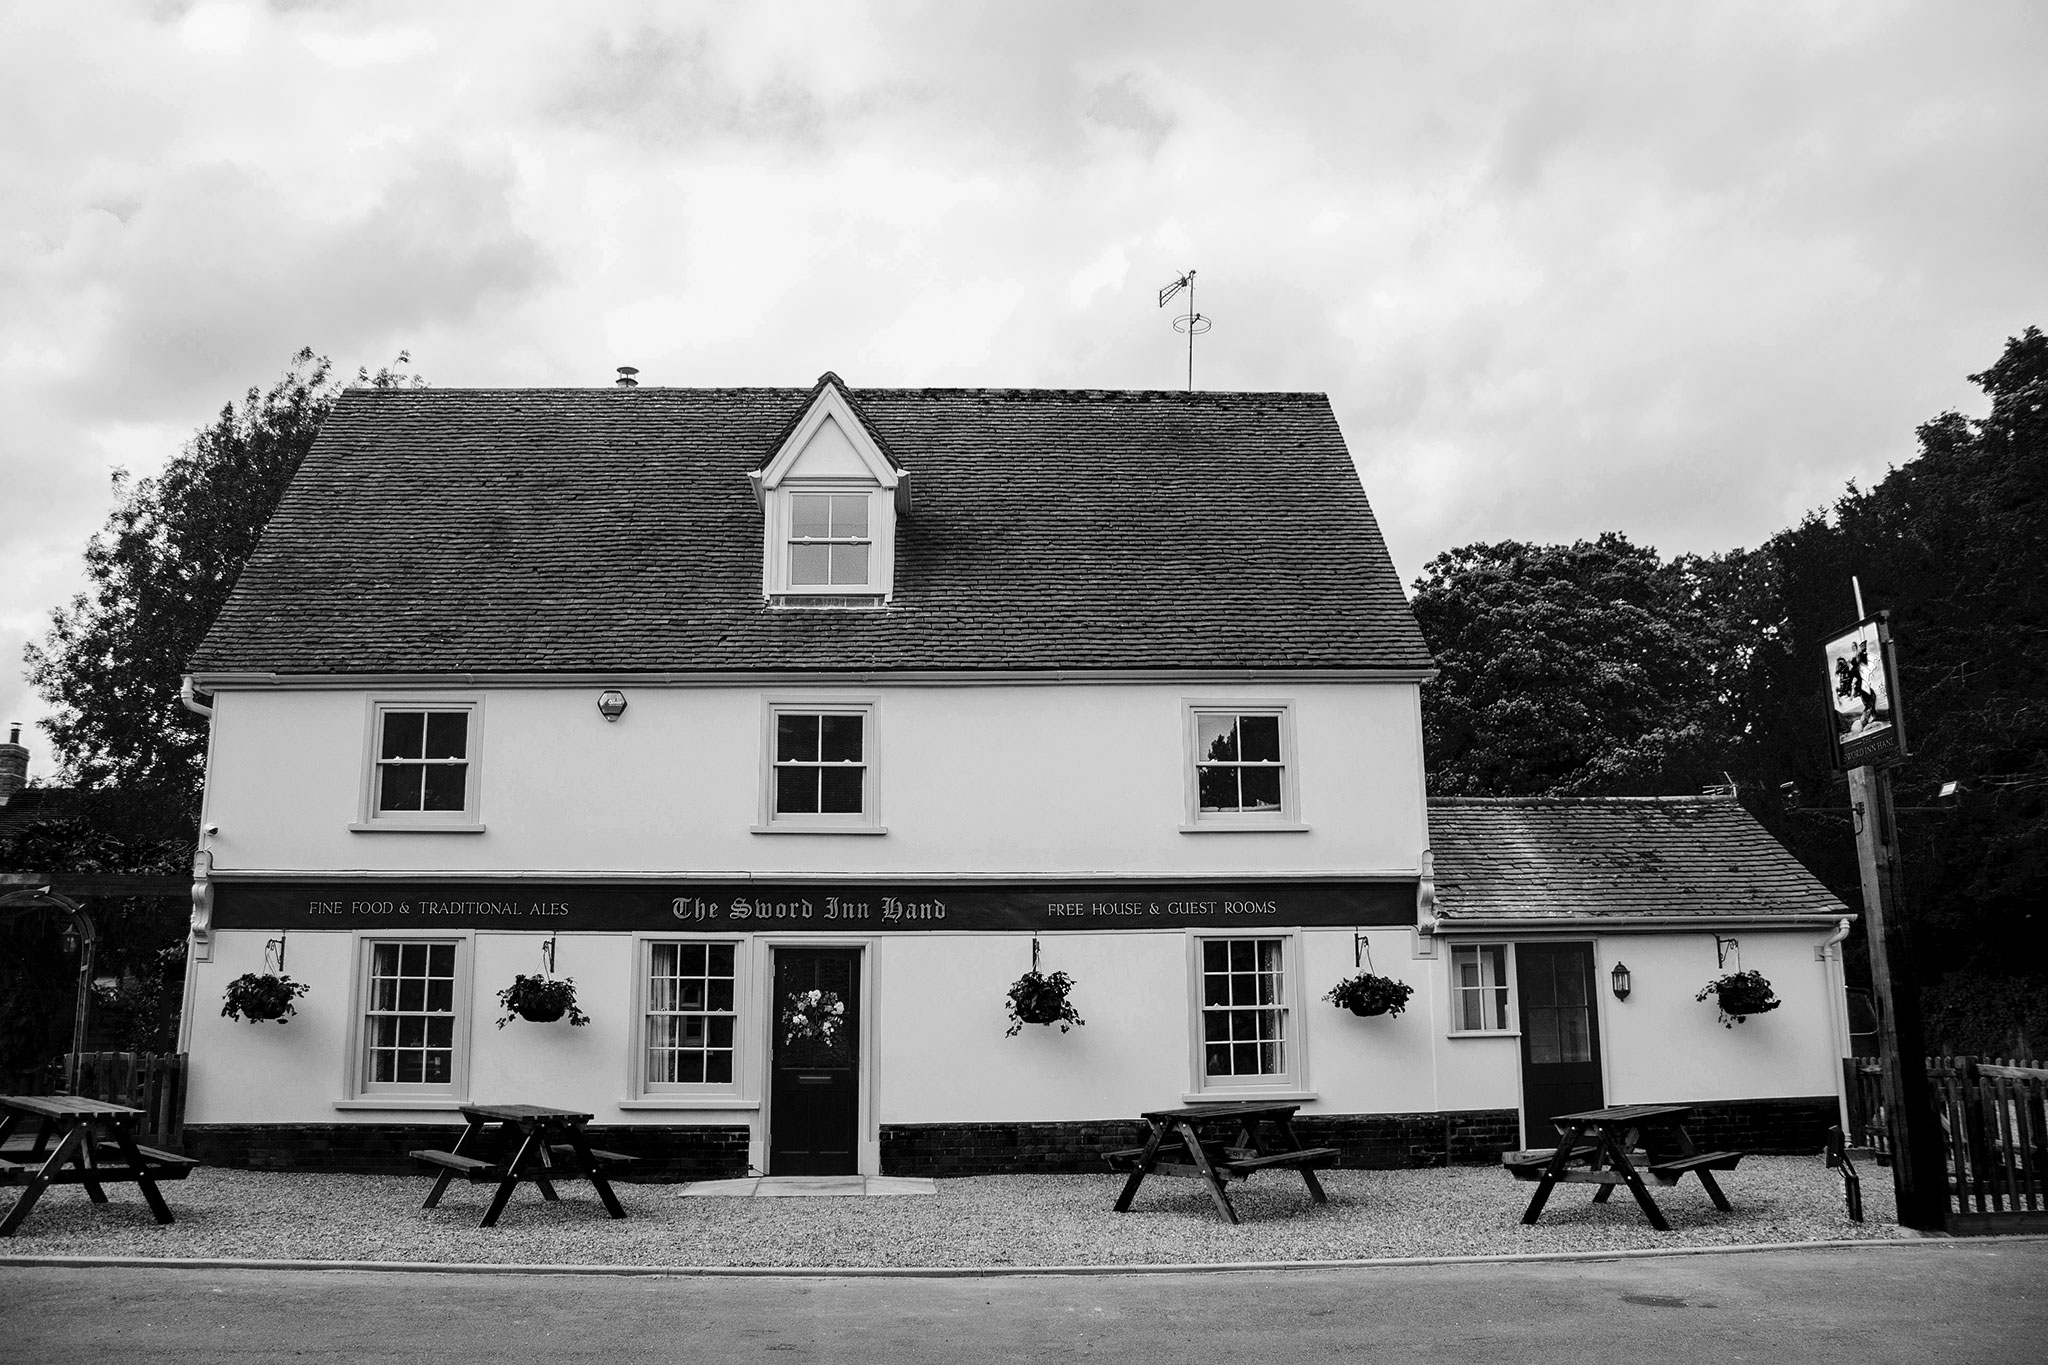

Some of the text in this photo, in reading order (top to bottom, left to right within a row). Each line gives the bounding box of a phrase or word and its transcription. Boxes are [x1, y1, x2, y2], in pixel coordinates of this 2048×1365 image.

[1864, 743, 1877, 755] INN
[309, 902, 569, 916] FINE FOOD & TRADITIONAL ALES
[672, 897, 946, 923] The Sword Inn Hand
[1048, 901, 1277, 916] FREE HOUSE & GUEST ROOMS
